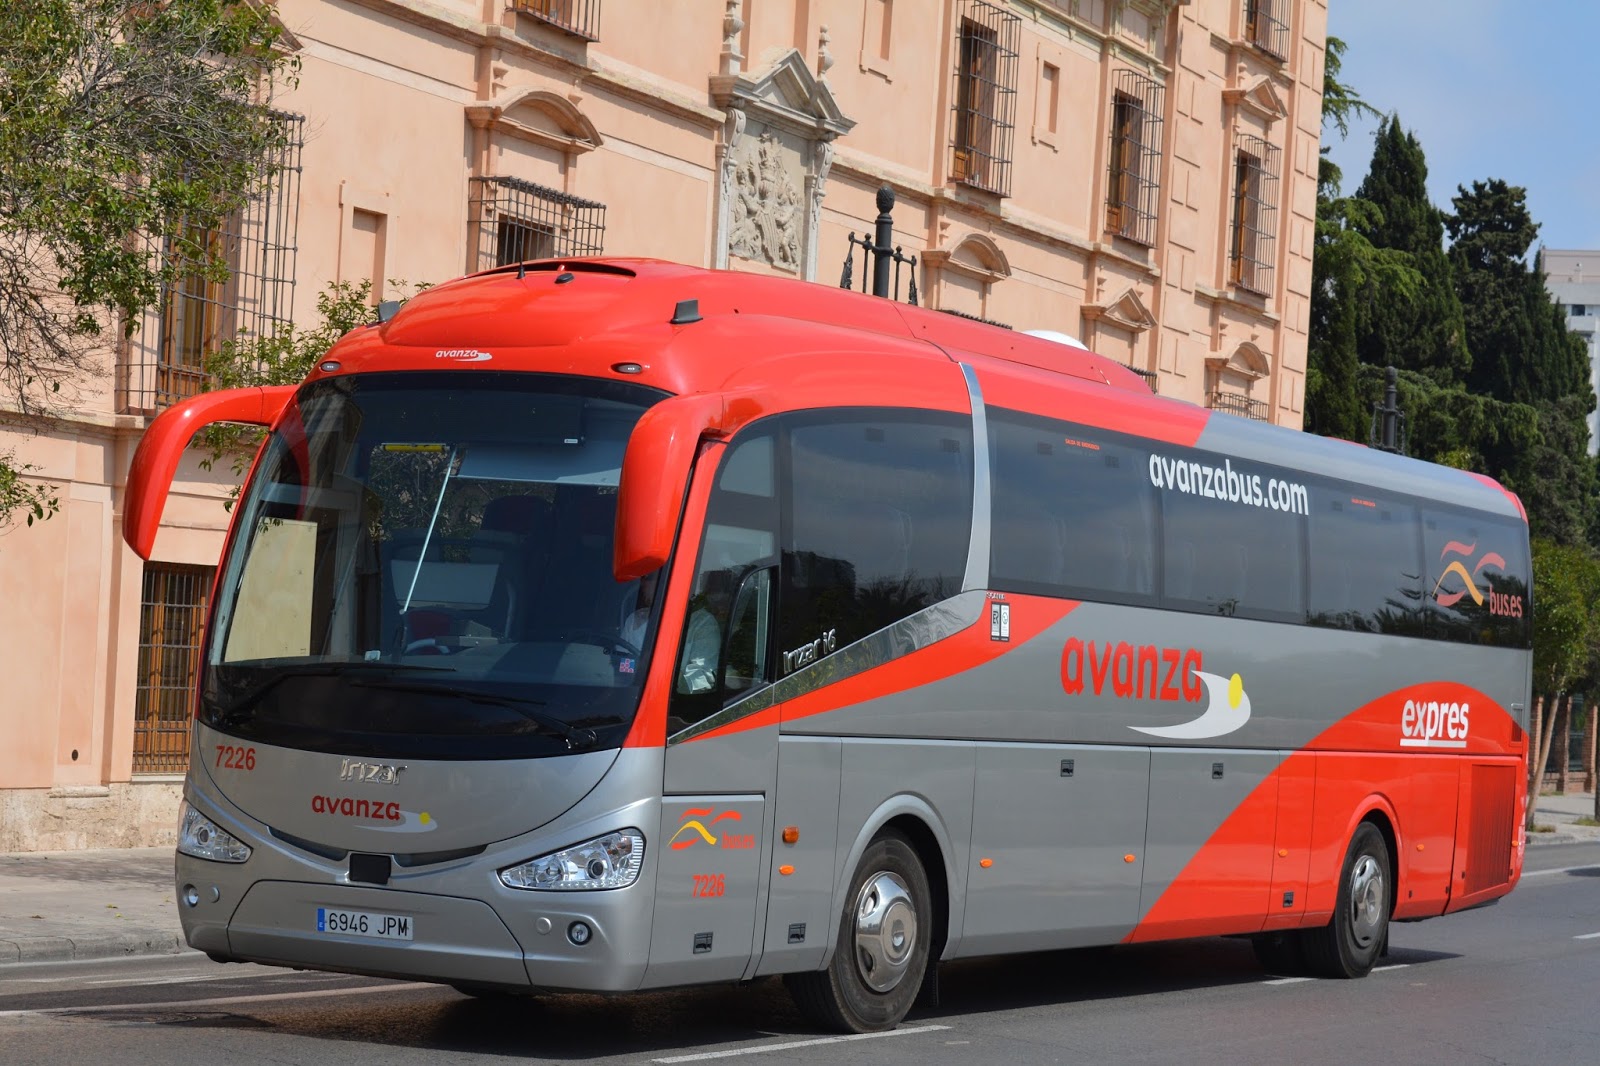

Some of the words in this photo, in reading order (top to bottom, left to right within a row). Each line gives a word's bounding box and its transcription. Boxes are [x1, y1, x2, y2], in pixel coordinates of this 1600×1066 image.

[435, 350, 478, 358] avanza
[1149, 453, 1309, 516] avanzabus.com
[1489, 584, 1523, 618] bus.es
[1060, 636, 1203, 703] avanza
[1401, 699, 1470, 743] expres
[215, 745, 257, 771] 7226
[311, 795, 400, 821] avanza
[692, 873, 726, 899] 7226
[328, 912, 369, 933] 6946
[377, 916, 409, 937] JPM
